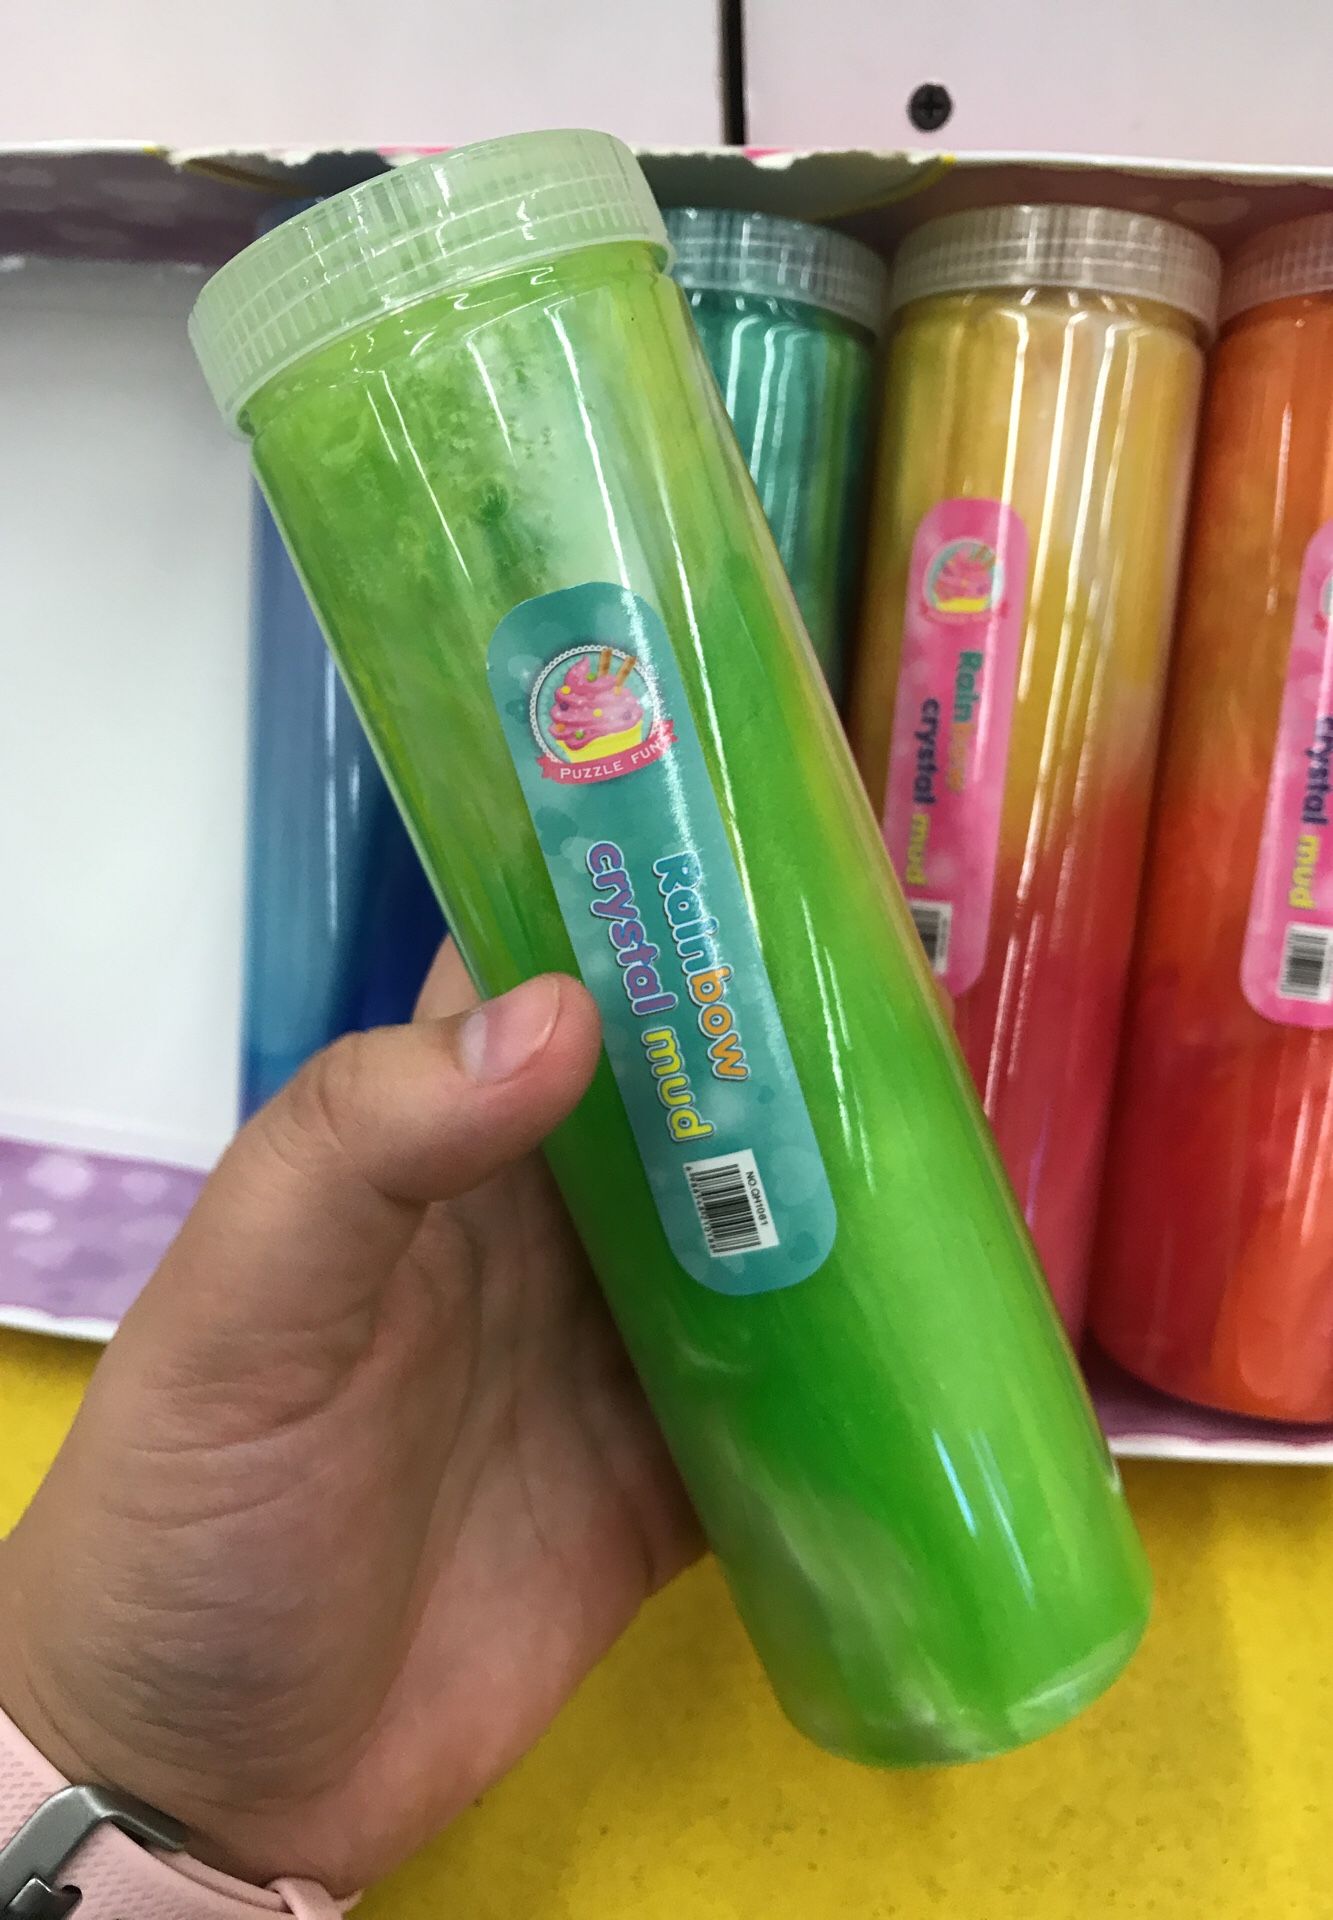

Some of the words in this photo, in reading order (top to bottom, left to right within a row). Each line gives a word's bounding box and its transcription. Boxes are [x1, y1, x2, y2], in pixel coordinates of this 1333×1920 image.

[559, 760, 624, 780] PUZZLE
[631, 741, 664, 765] FUN
[914, 698, 939, 805] crystal
[906, 813, 930, 886] mud
[1288, 834, 1320, 910] mud
[586, 841, 678, 1016] crystal
[641, 1026, 715, 1143] mud
[653, 851, 750, 1080] Rainbow
